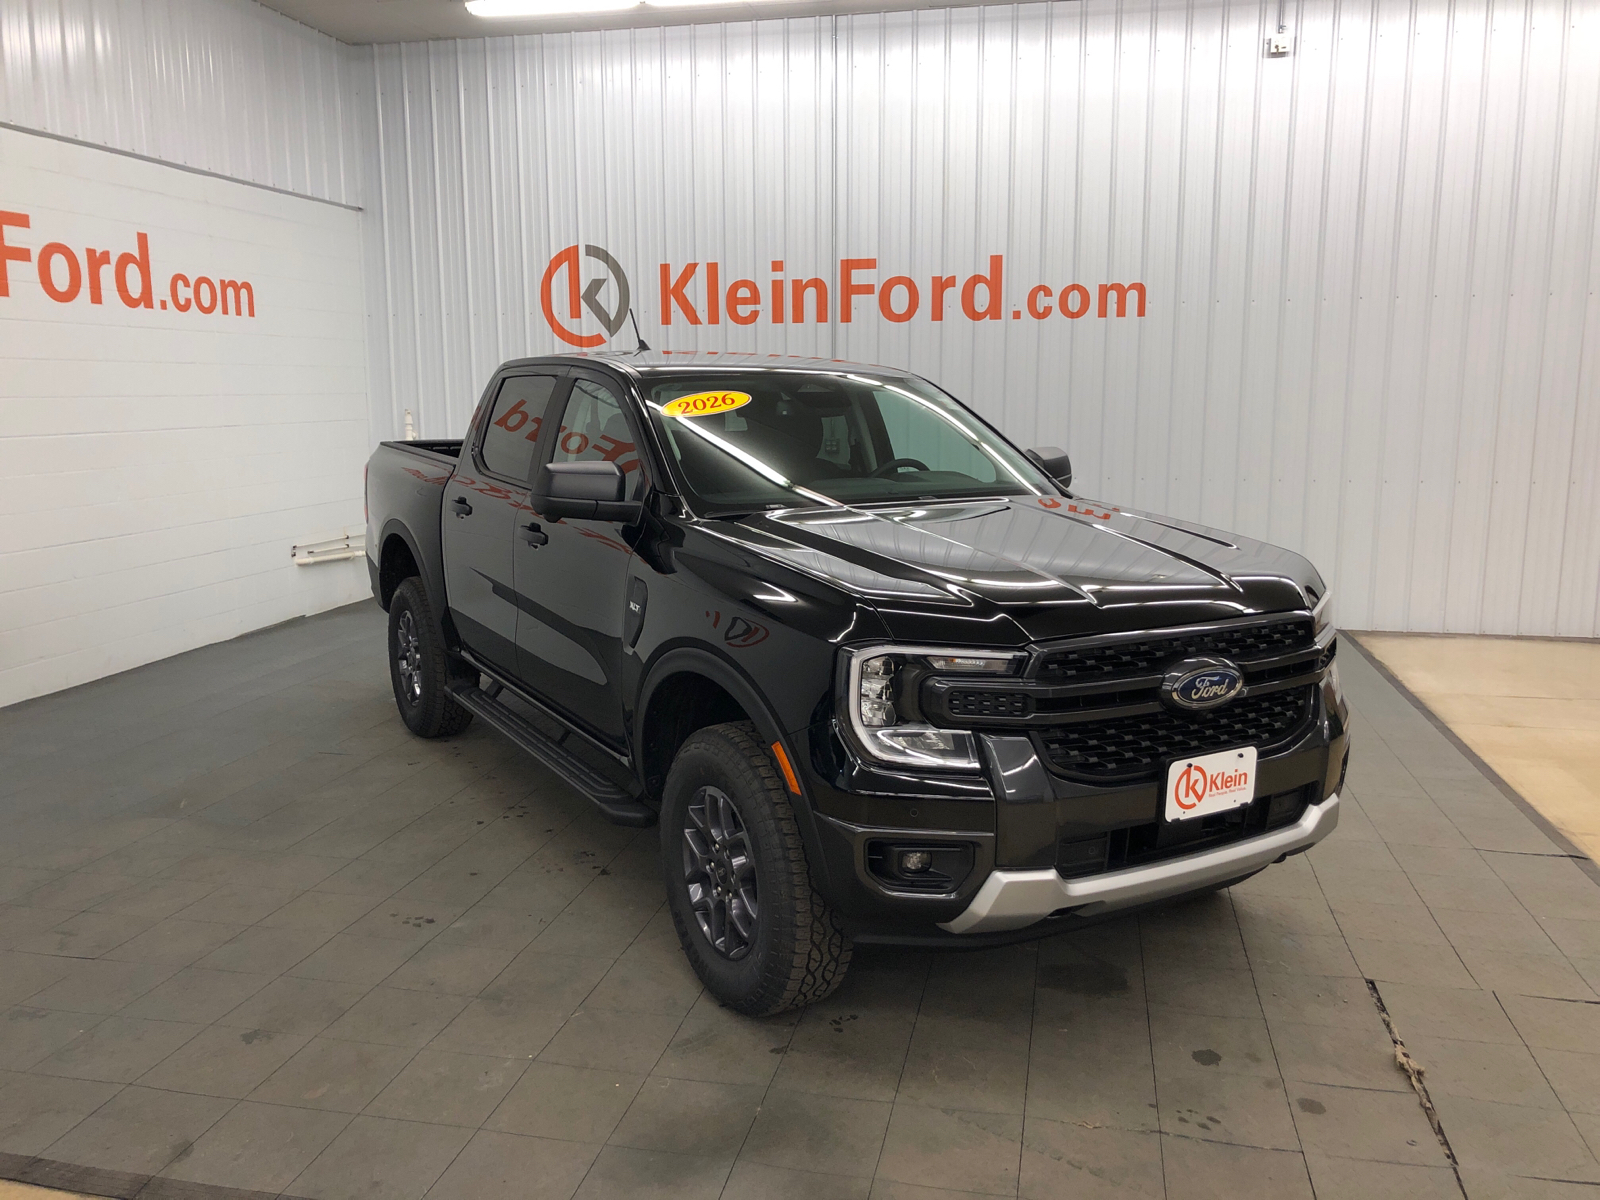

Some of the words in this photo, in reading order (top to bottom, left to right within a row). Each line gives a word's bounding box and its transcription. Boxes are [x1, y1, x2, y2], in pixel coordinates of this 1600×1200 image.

[660, 255, 1147, 325] KleinFord.com
[677, 393, 735, 414] 2026
[1191, 676, 1229, 699] Ford
[1209, 769, 1248, 792] Klein
